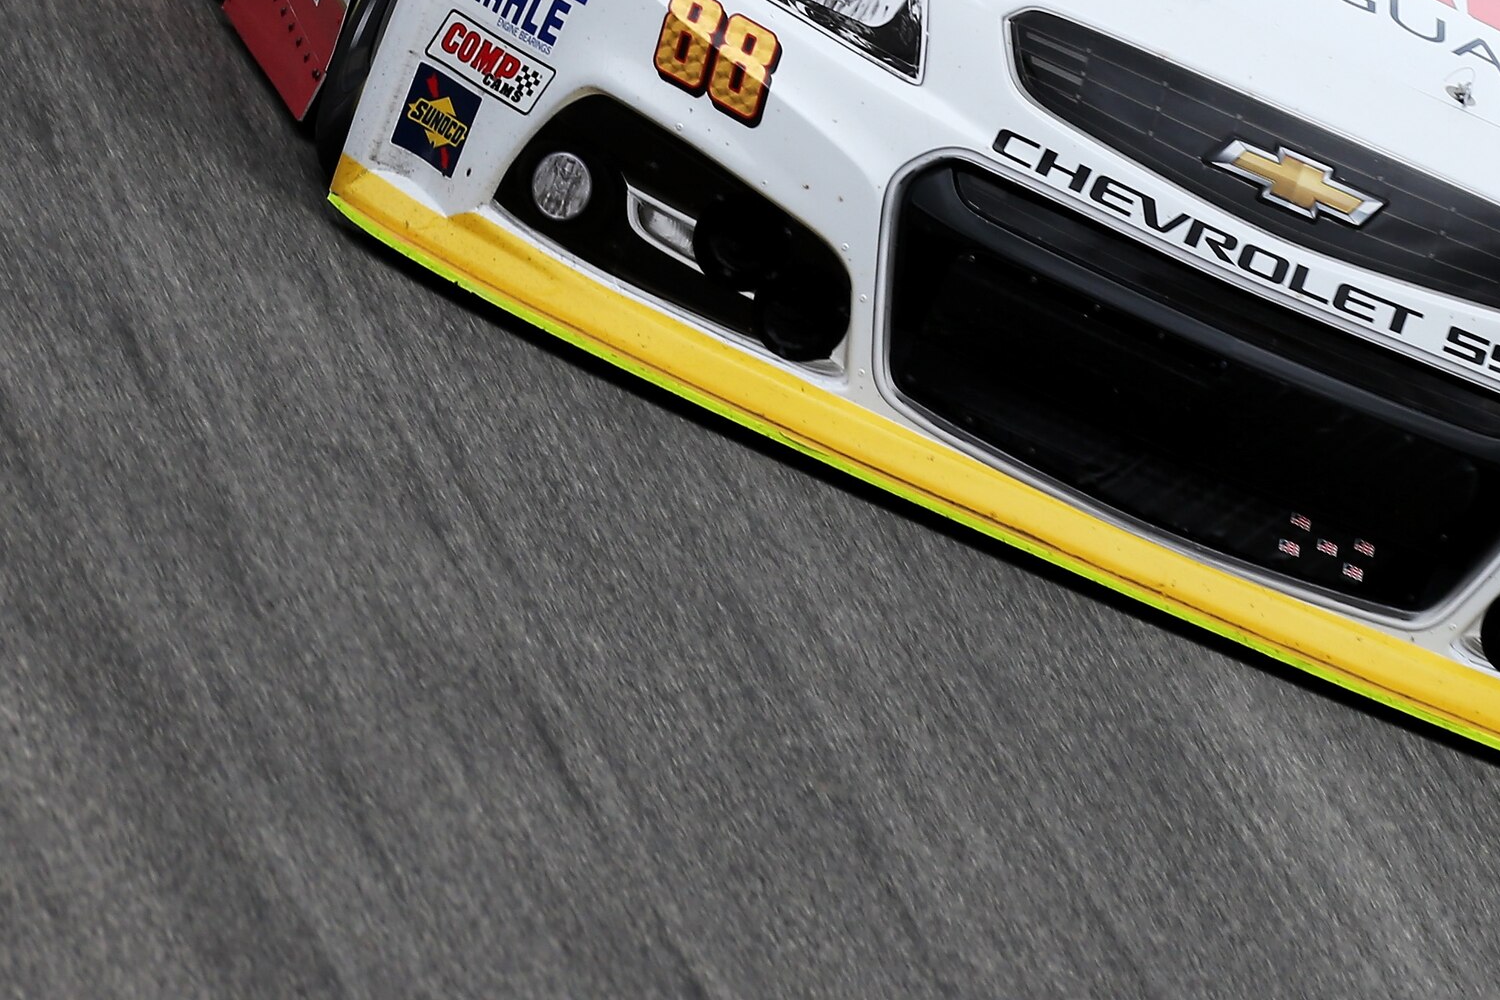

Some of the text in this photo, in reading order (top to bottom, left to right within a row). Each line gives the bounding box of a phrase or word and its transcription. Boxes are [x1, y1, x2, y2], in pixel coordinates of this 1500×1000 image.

[441, 22, 522, 80] COMP
[496, 17, 553, 56] ENGINE BEARINGS
[482, 73, 524, 104] CAMS
[411, 99, 467, 145] SUNOCO
[992, 128, 1424, 334] CHEVROLET
